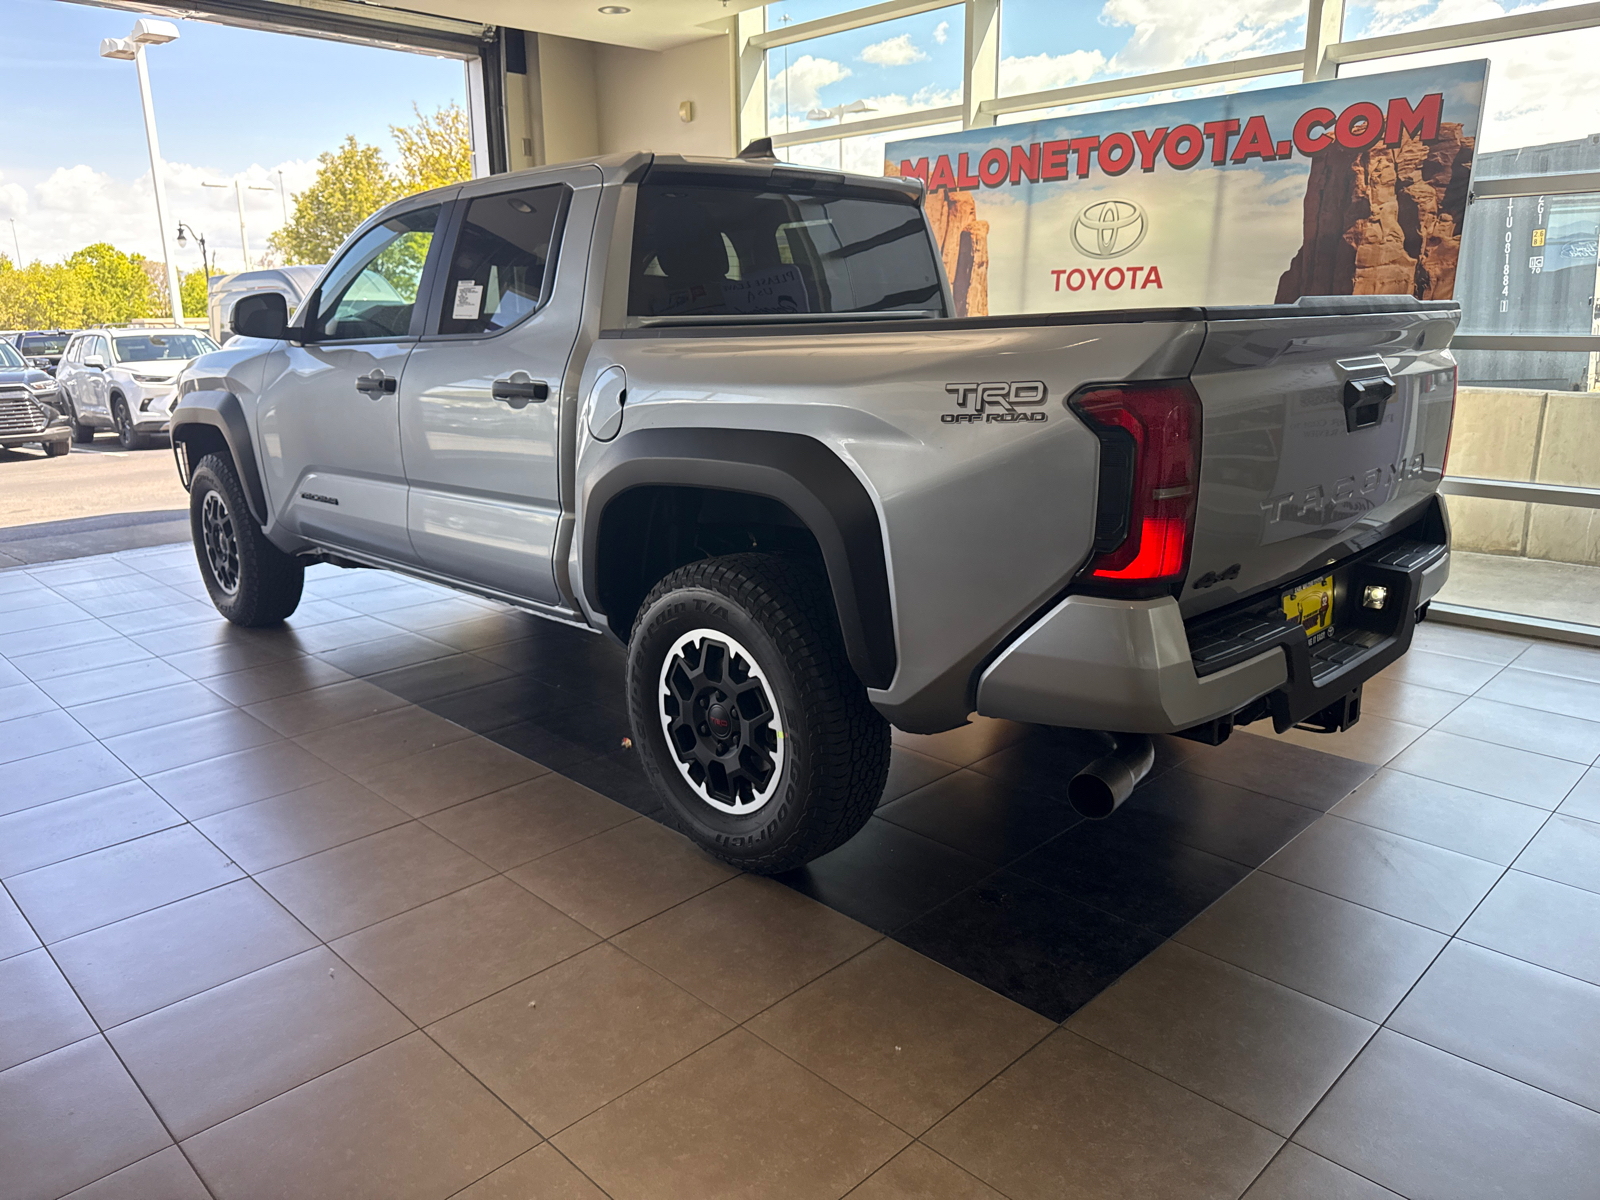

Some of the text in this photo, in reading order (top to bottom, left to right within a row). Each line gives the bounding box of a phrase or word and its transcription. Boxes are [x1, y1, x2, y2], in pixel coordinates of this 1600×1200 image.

[901, 93, 1444, 194] MALONETOYOTA.COM
[1051, 266, 1163, 291] TOYOTA
[1502, 231, 1512, 297] 081884
[945, 380, 1048, 414] TRD
[941, 412, 1048, 424] OFF ROAD
[1259, 453, 1424, 524] TACOMA
[710, 716, 728, 727] TRD
